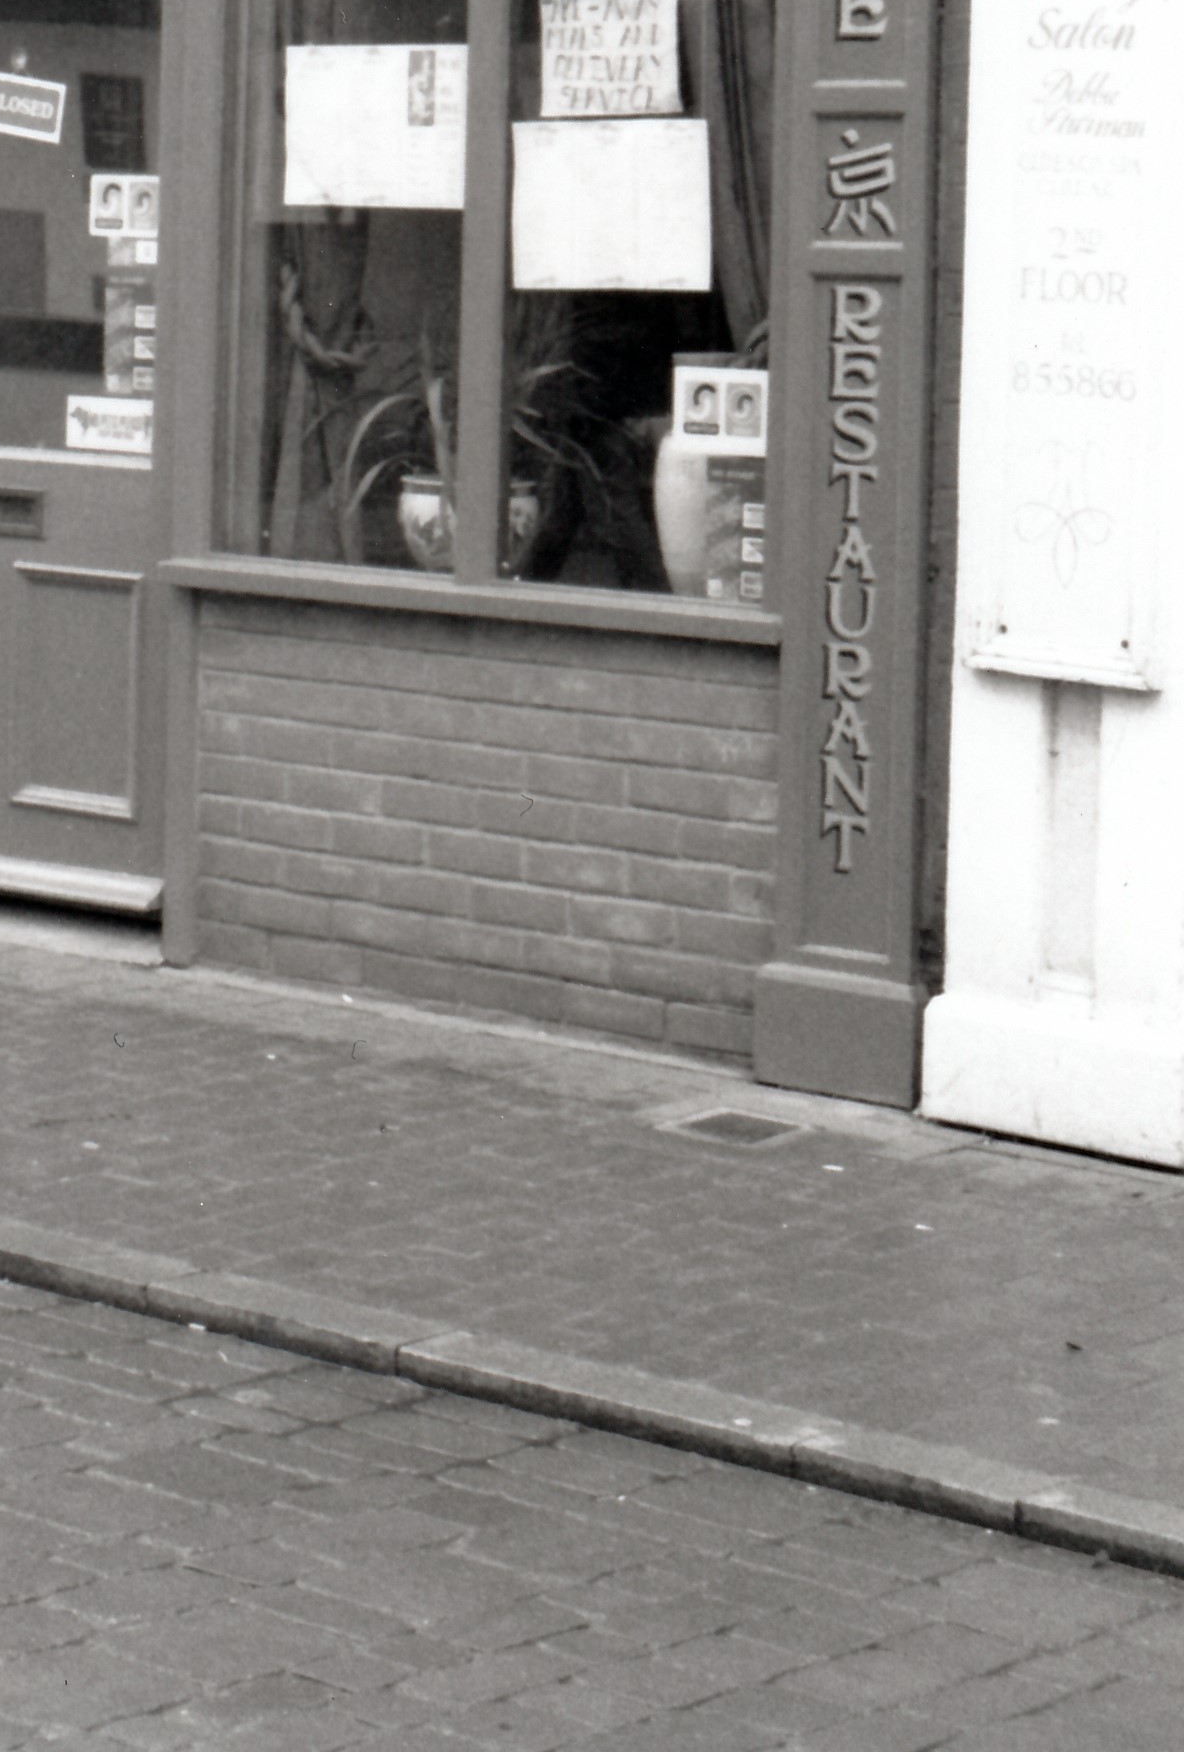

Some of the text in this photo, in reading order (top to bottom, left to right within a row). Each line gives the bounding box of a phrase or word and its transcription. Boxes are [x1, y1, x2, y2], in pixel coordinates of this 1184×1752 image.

[1027, 6, 1136, 50] Salon
[1020, 266, 1128, 306] FLOOR
[821, 285, 882, 871] RESTAURANT
